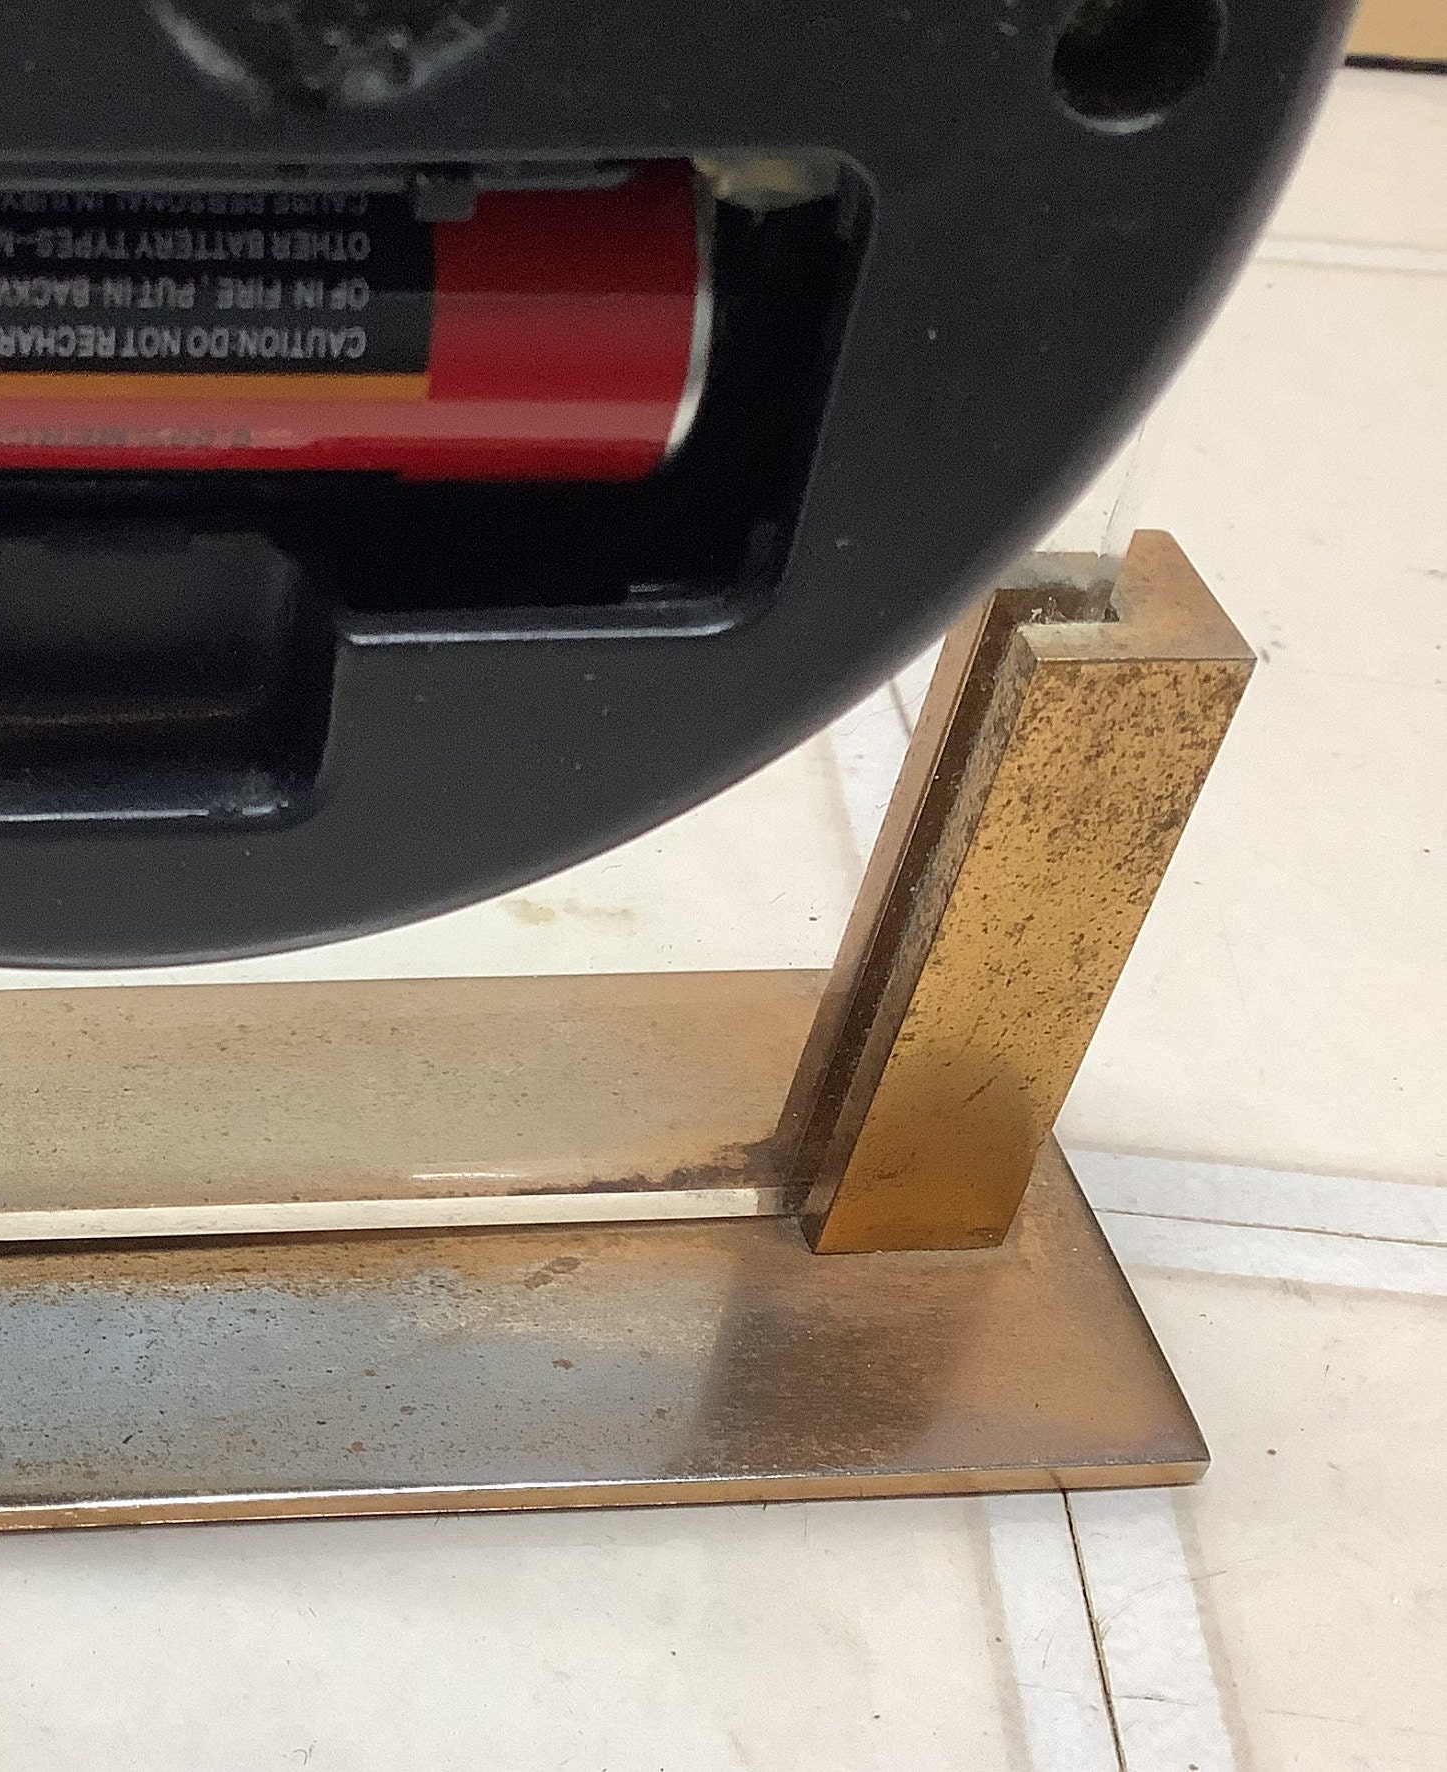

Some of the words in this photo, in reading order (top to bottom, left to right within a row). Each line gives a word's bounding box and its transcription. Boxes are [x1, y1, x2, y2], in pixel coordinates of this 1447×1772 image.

[134, 228, 266, 261] BATTERY
[271, 230, 371, 262] OTHER
[103, 275, 133, 308] IN
[139, 275, 197, 309] PUT
[293, 275, 324, 309] IN
[329, 276, 371, 310] OF
[120, 326, 182, 358] NOT
